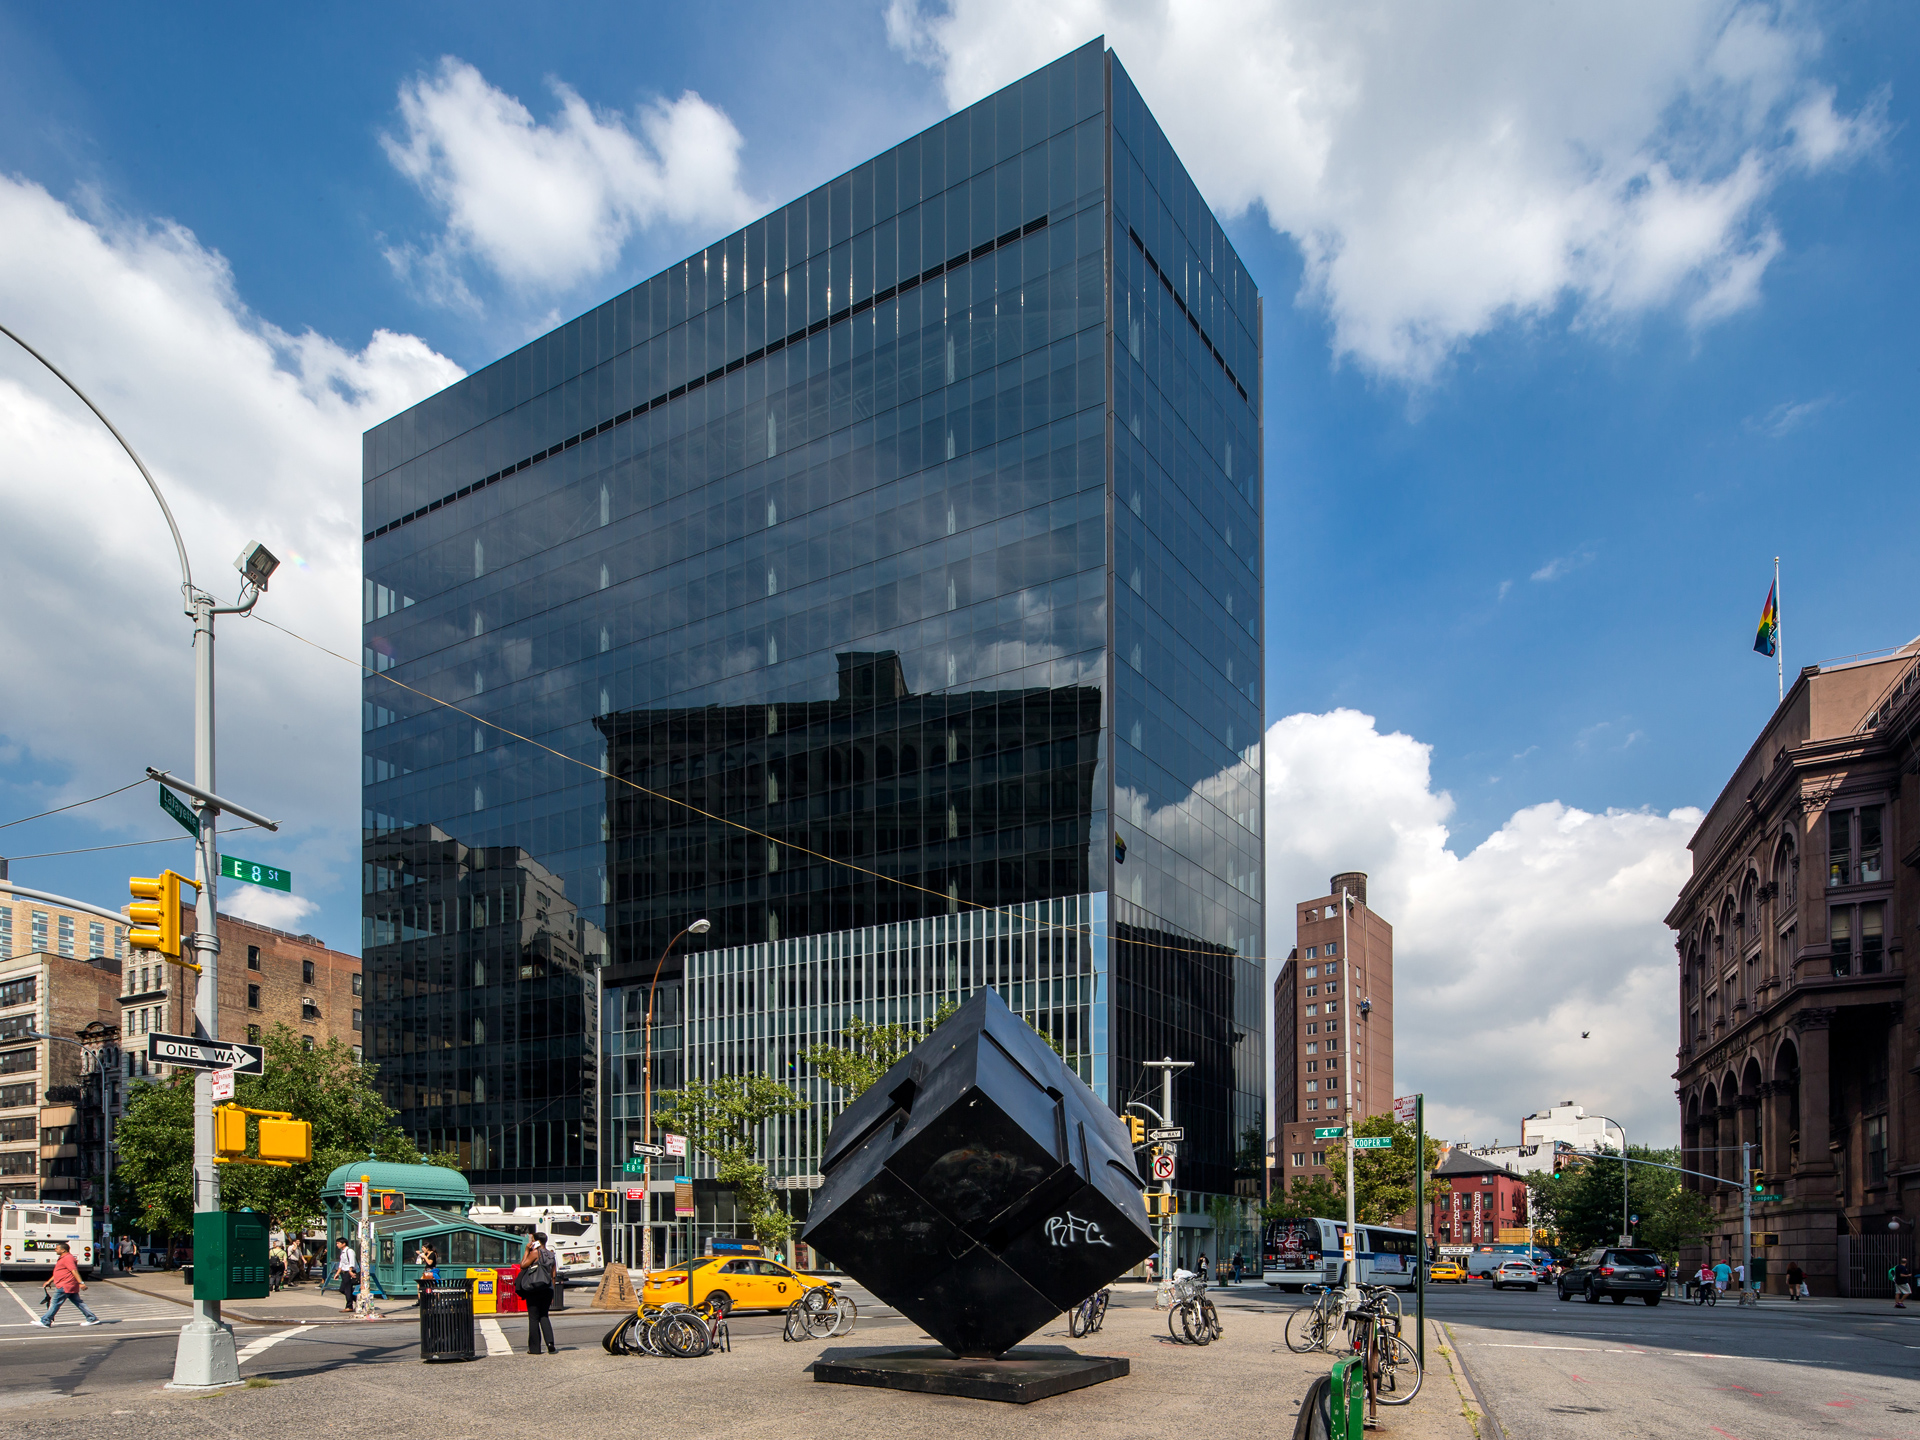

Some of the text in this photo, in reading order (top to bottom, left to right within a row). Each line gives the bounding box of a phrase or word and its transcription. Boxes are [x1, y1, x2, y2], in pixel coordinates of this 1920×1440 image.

[164, 789, 197, 827] Lafayette
[234, 860, 279, 882] E 8 St
[166, 1044, 198, 1058] ONE
[214, 1049, 246, 1063] WAY
[1394, 1100, 1402, 1109] NO
[1322, 1129, 1328, 1137] 4
[1355, 1139, 1380, 1147] COOPER
[631, 1164, 636, 1172] 8
